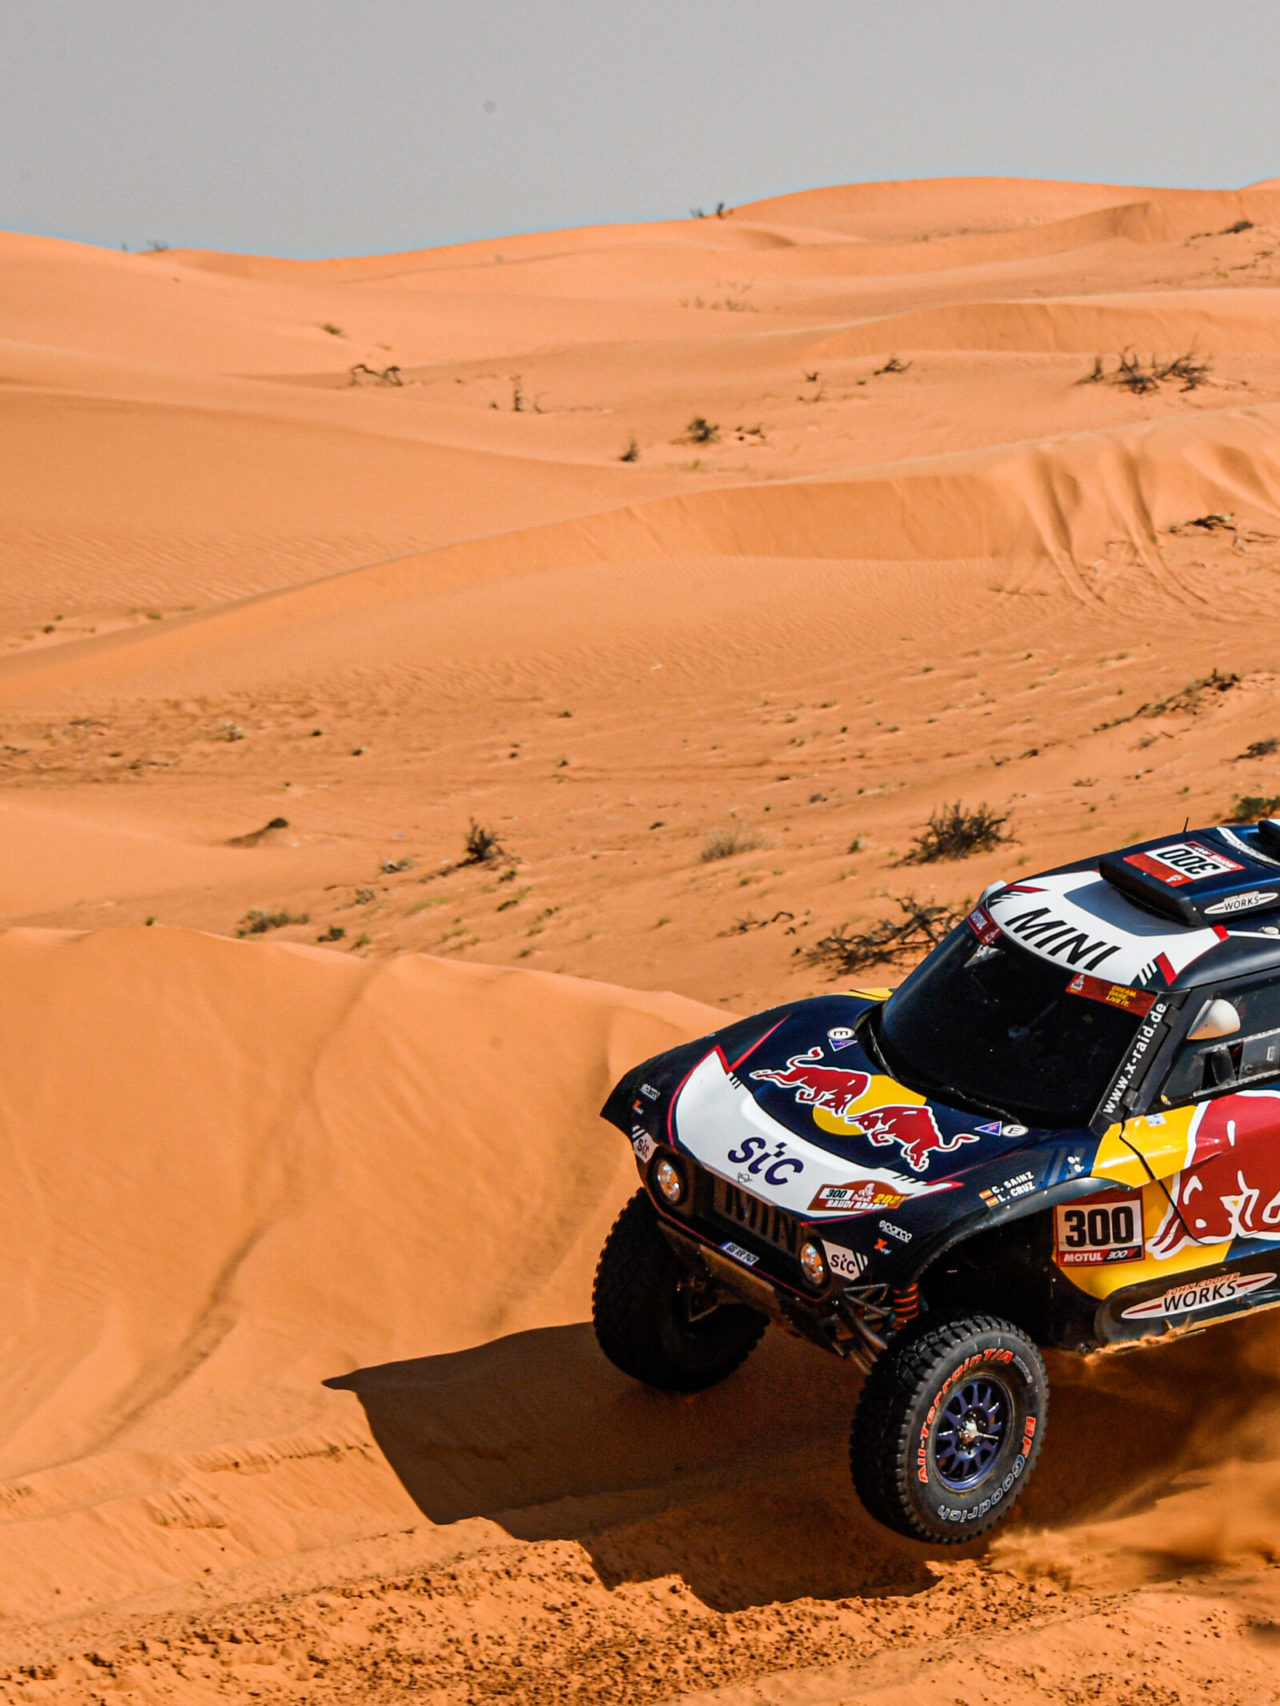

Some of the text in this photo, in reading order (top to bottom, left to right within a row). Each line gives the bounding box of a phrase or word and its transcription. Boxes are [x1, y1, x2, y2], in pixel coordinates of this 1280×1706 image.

[1156, 848, 1221, 875] 300
[1224, 896, 1260, 911] WORKS
[1004, 907, 1122, 972] MINI
[1103, 1002, 1167, 1114] www.x-raid.de
[727, 1137, 804, 1185] stc
[826, 1189, 848, 1198] 300
[991, 1171, 1035, 1194] C. SAINZ
[997, 1181, 1036, 1203] L. CRUZ
[826, 1200, 854, 1208] SAUDI
[879, 1220, 912, 1243] sparco
[1064, 1206, 1134, 1247] 300
[830, 1254, 856, 1274] stc
[1063, 1252, 1103, 1263] MOTUL
[1195, 1272, 1241, 1290] COOPER
[1163, 1280, 1238, 1312] WORKS
